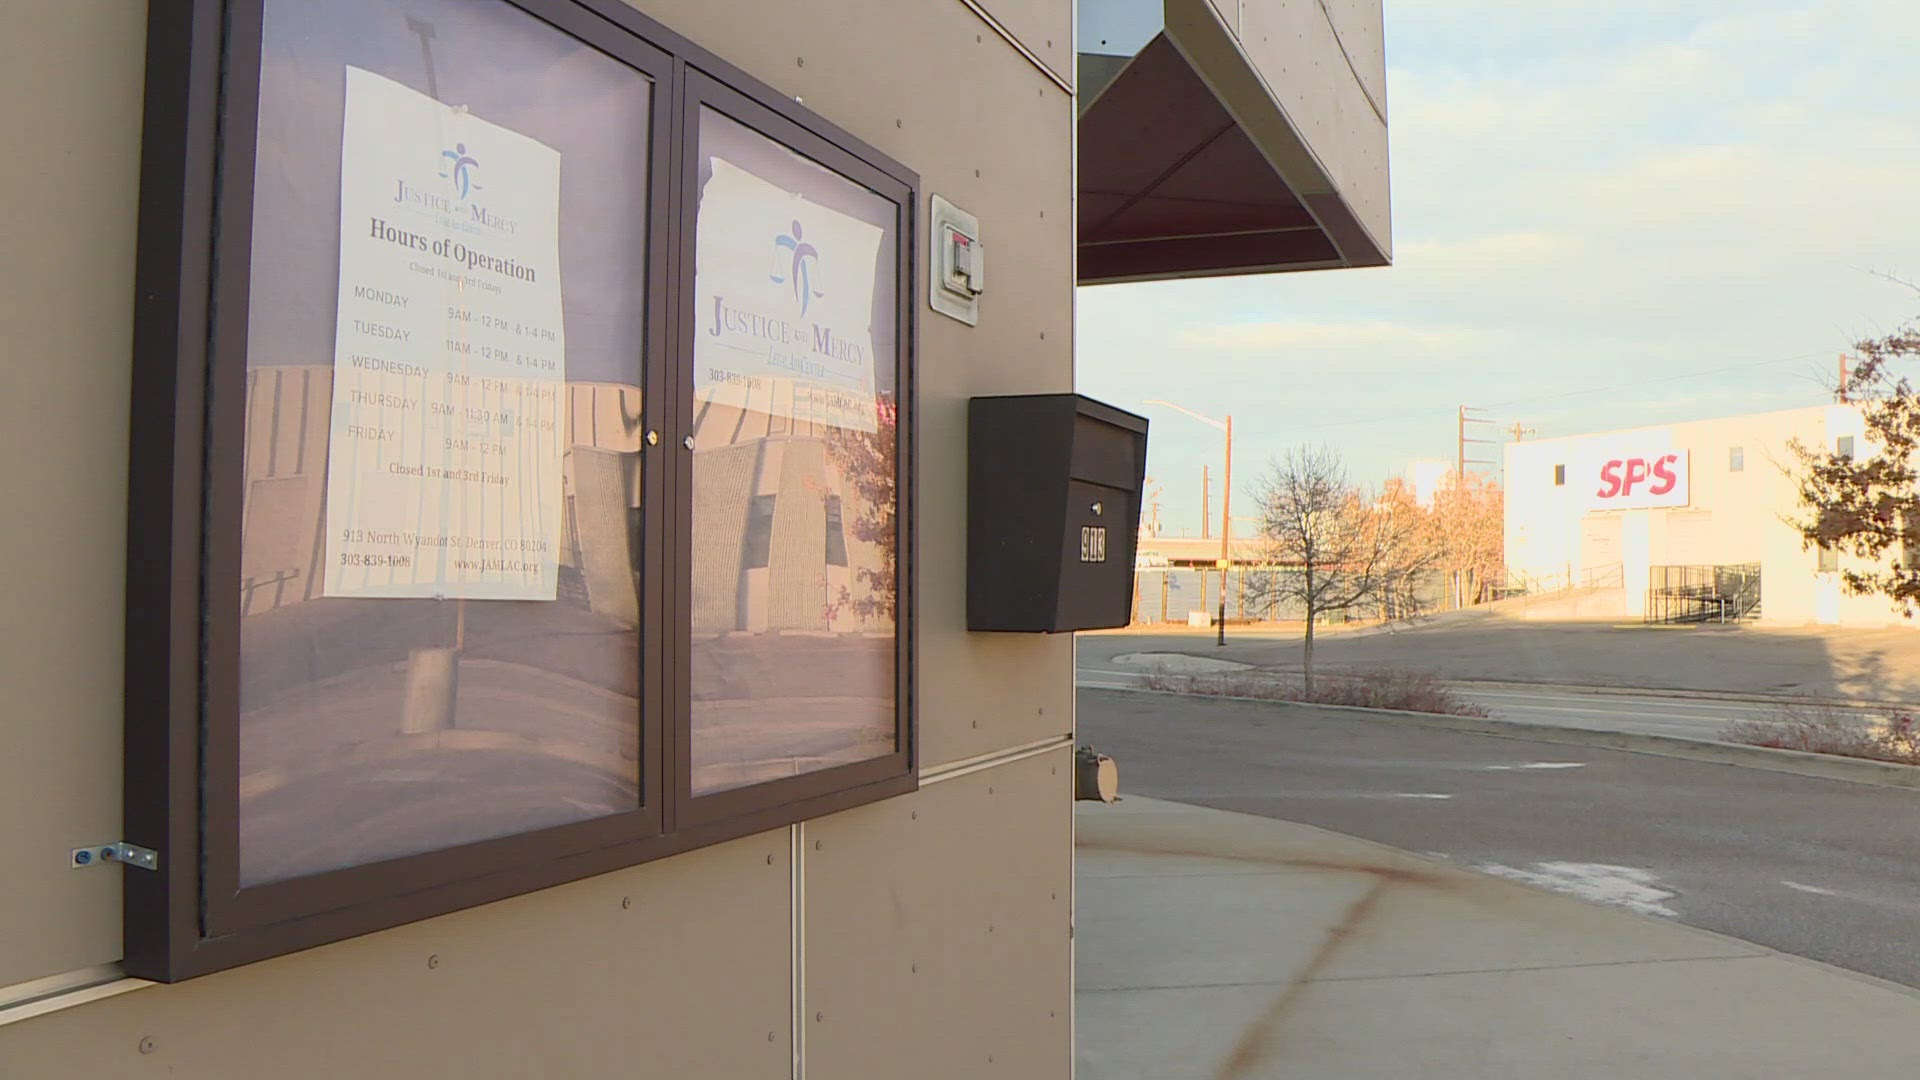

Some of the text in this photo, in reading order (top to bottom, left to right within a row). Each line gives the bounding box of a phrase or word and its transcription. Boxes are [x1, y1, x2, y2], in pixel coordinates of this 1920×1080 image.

[471, 203, 517, 234] MERCY
[370, 217, 428, 251] Hours
[432, 238, 451, 258] of
[454, 243, 536, 282] Operation
[409, 261, 435, 277] Closed
[355, 286, 409, 309] MONDAY
[354, 320, 410, 342] TUESDAY
[448, 307, 471, 323] 9AM
[481, 315, 492, 328] 12
[494, 318, 508, 332] PM
[515, 323, 522, 335] &
[542, 330, 555, 342] PM
[709, 295, 790, 345] JUSTICE
[812, 323, 864, 366] MERCY
[351, 354, 430, 380] WEDNESDAY
[446, 339, 471, 355] 11AM
[481, 346, 492, 359] 12
[494, 350, 508, 363] PM
[515, 354, 522, 366] &
[542, 359, 556, 372] PM
[447, 373, 470, 387] 9AM
[481, 379, 492, 392] 12
[351, 390, 417, 411] THURSDAY
[431, 402, 455, 416] 9AM
[465, 408, 490, 422] 11:30
[493, 413, 508, 425] AM
[348, 425, 394, 442] FRIDAY
[445, 438, 469, 452] 9AM
[480, 442, 491, 454] 12
[492, 444, 507, 456] PM
[389, 462, 510, 489] Closed 1st and 3rd Friday
[1596, 454, 1678, 498] SPS
[343, 529, 363, 543] 913
[367, 530, 399, 546] North
[504, 538, 518, 551] CO
[520, 539, 548, 553] 80204
[1082, 527, 1105, 560] 913
[340, 552, 411, 568] 303-839-1008
